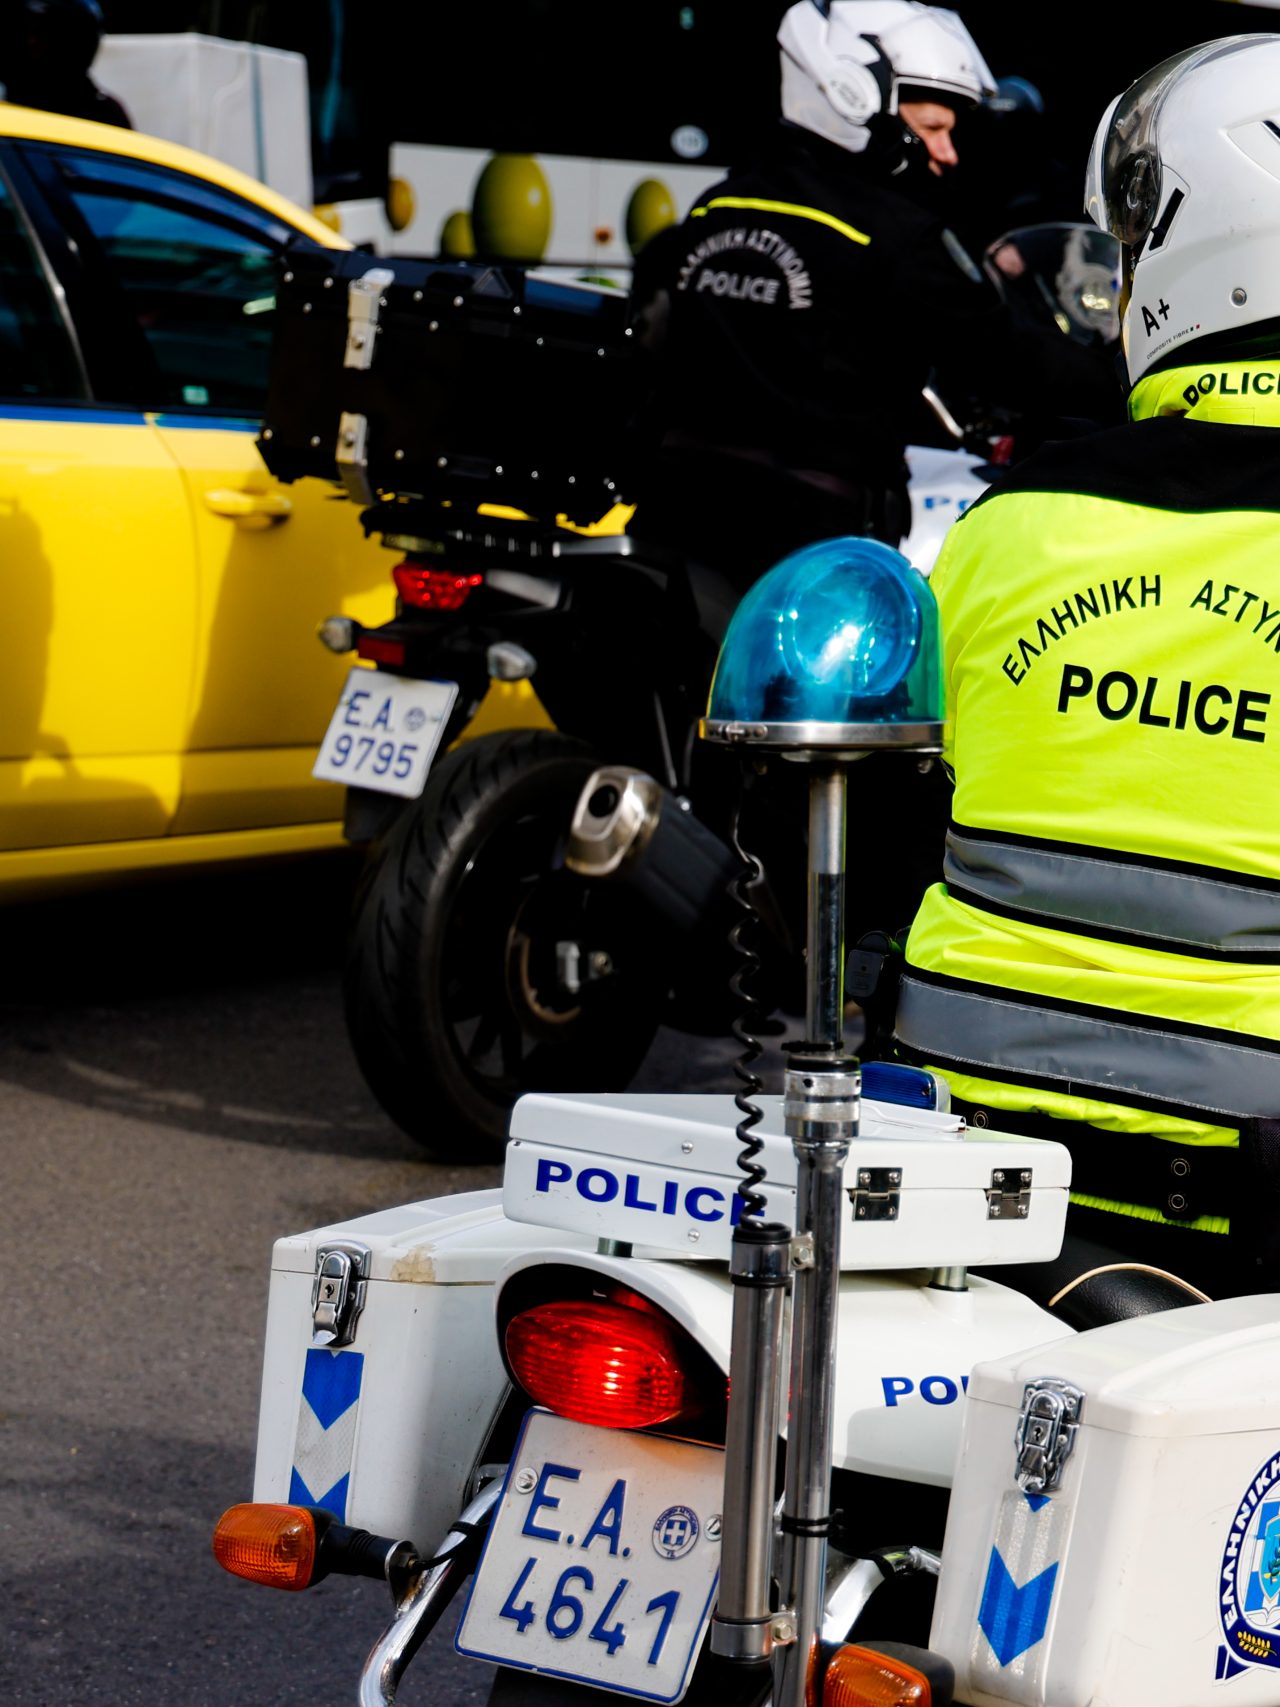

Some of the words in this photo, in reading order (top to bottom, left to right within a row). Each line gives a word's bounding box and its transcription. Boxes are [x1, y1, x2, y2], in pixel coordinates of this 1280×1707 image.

[696, 269, 781, 304] POLICE
[1141, 298, 1170, 337] A+
[1146, 338, 1171, 360] COMPOSITE
[1002, 574, 1162, 686] ΕΛΛΗΝΙΚΗ
[1057, 663, 1272, 743] POLICE
[330, 734, 418, 779] 9795
[881, 1375, 969, 1408] PO
[499, 1557, 681, 1665] 4641
